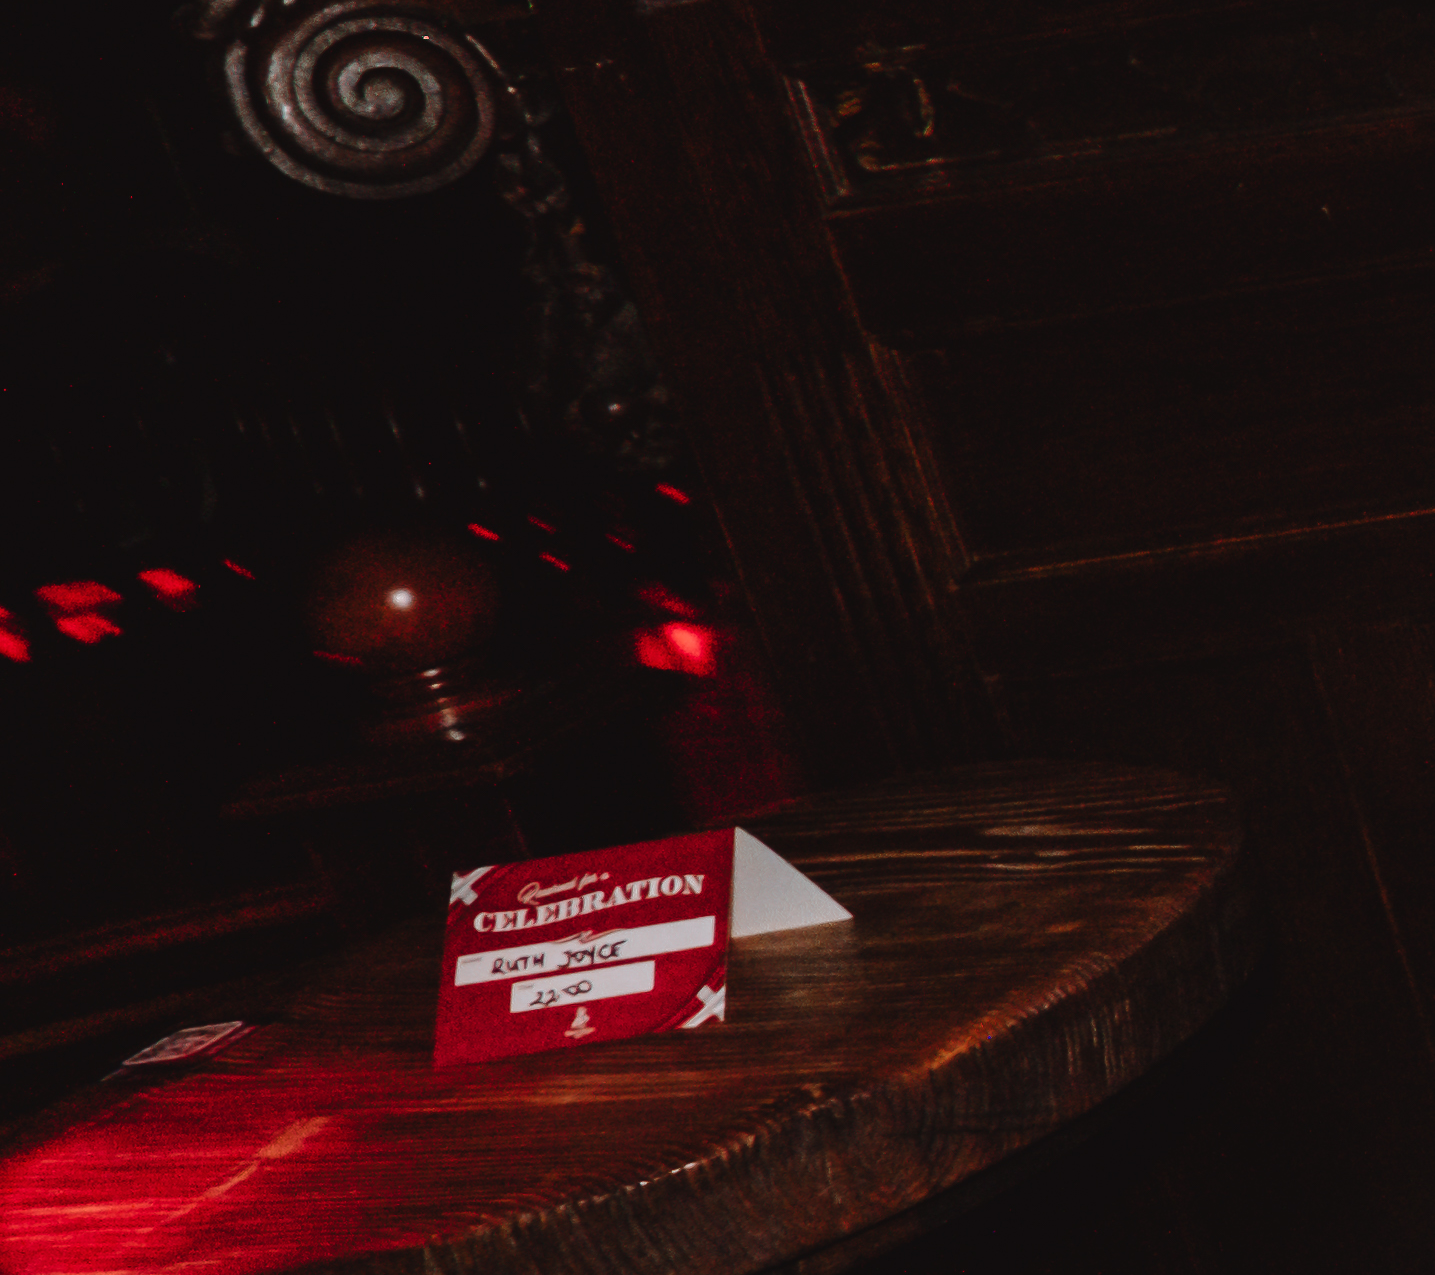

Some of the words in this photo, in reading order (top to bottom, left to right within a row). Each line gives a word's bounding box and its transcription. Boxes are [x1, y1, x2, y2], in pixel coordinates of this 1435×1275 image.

[475, 874, 705, 932] CELEBRATION
[491, 953, 545, 974] RUTH
[557, 939, 628, 969] JOYCE
